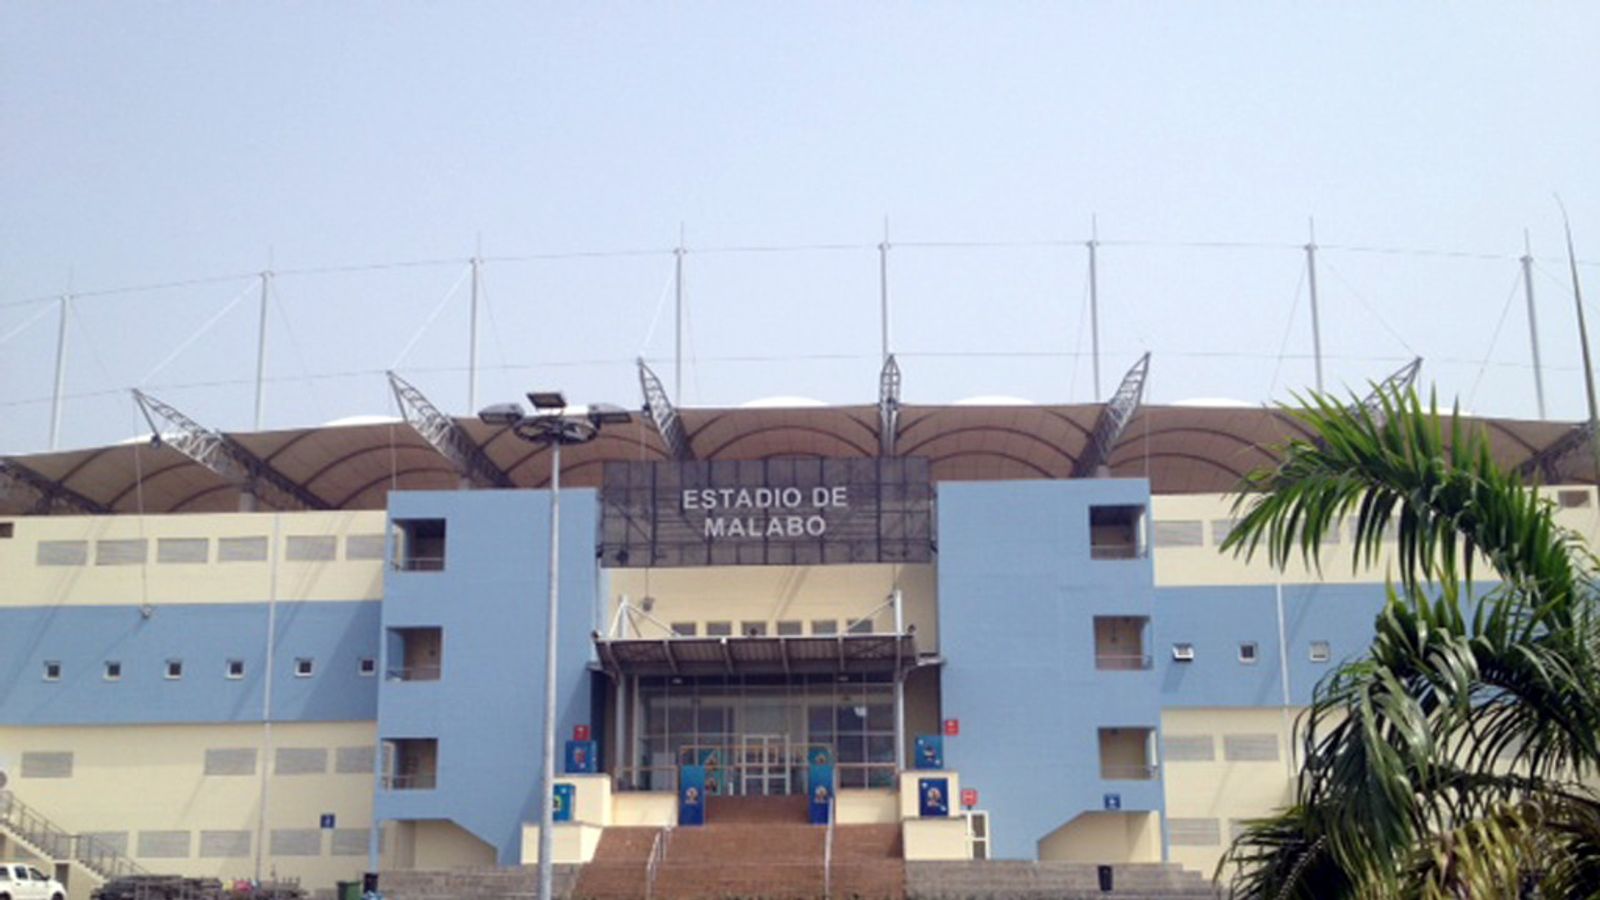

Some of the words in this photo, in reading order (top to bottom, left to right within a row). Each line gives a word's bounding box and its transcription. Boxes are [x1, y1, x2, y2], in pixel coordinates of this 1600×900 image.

[682, 488, 802, 509] ESTADIO
[812, 487, 847, 507] DE
[704, 515, 826, 537] MALABO
